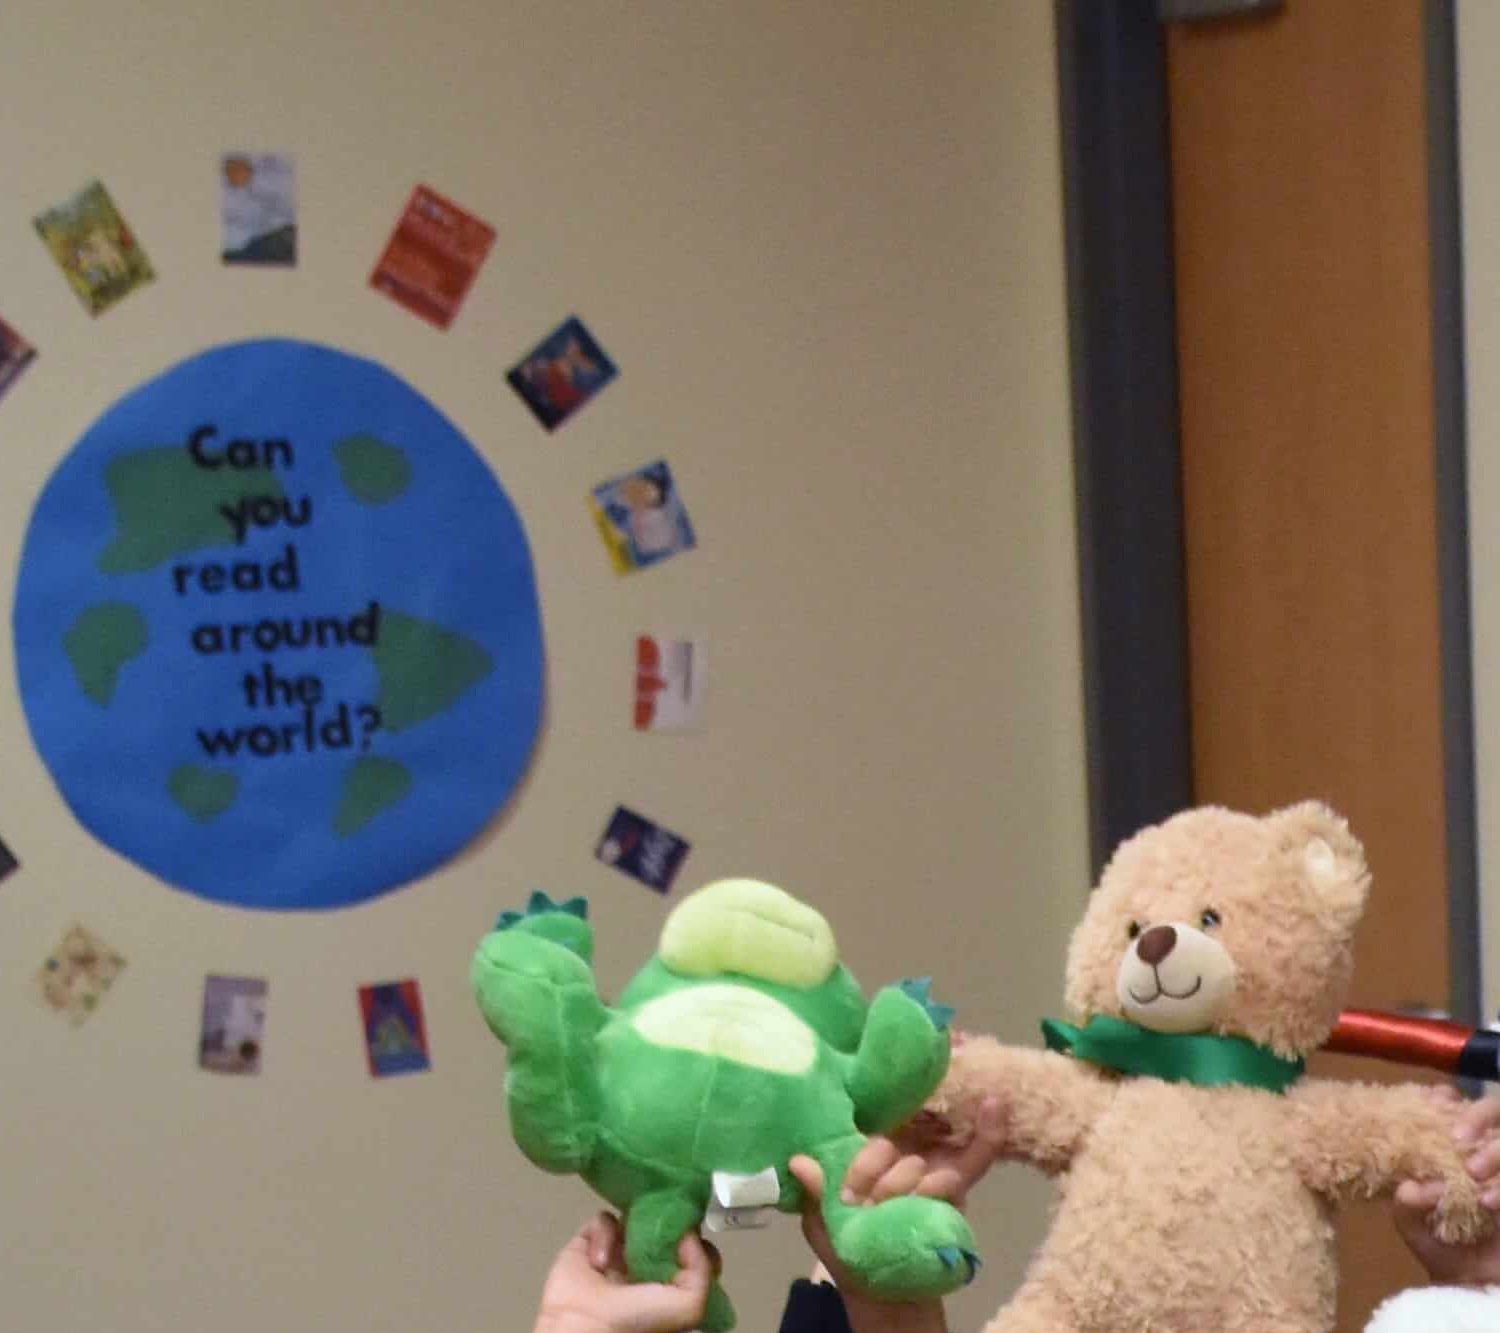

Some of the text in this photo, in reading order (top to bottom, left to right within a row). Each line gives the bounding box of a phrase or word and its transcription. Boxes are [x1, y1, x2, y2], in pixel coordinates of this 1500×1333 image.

[186, 424, 294, 472] Can
[219, 495, 312, 546] you
[171, 543, 300, 596] read
[190, 601, 380, 655] around
[243, 661, 323, 708] the
[195, 703, 381, 757] world?
